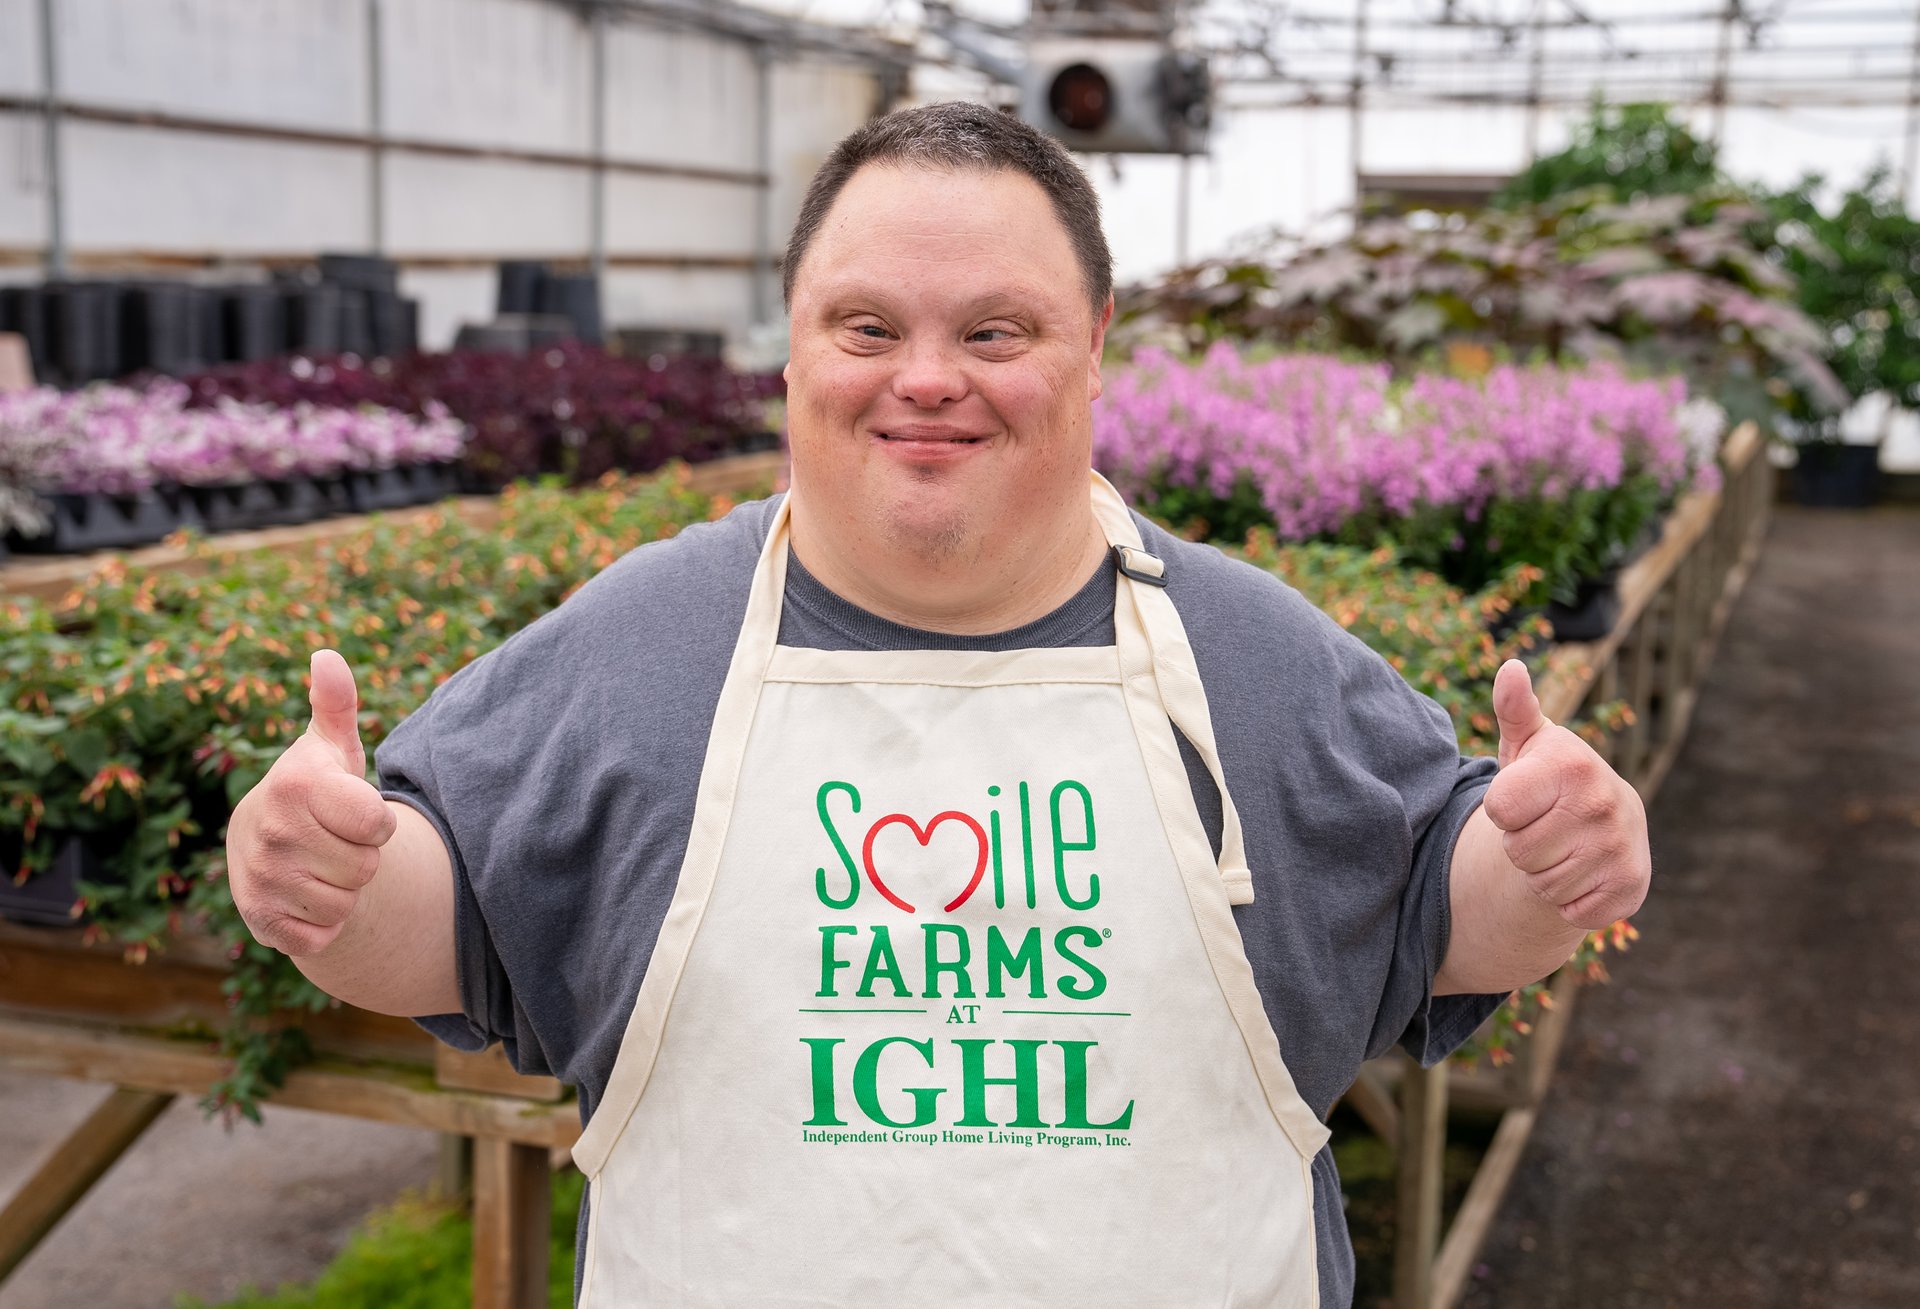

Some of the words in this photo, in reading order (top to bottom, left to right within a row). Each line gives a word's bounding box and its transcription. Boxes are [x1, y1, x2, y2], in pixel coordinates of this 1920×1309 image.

[815, 780, 1101, 914] Smile
[945, 1004, 982, 1025] AT
[799, 1036, 1136, 1131] IGHL
[802, 1129, 888, 1145] Independent
[891, 1130, 938, 1147] Group
[941, 1130, 984, 1143] Home
[987, 1131, 1034, 1147] Living
[1036, 1131, 1102, 1148] Program,
[1104, 1133, 1133, 1148] Inc.
